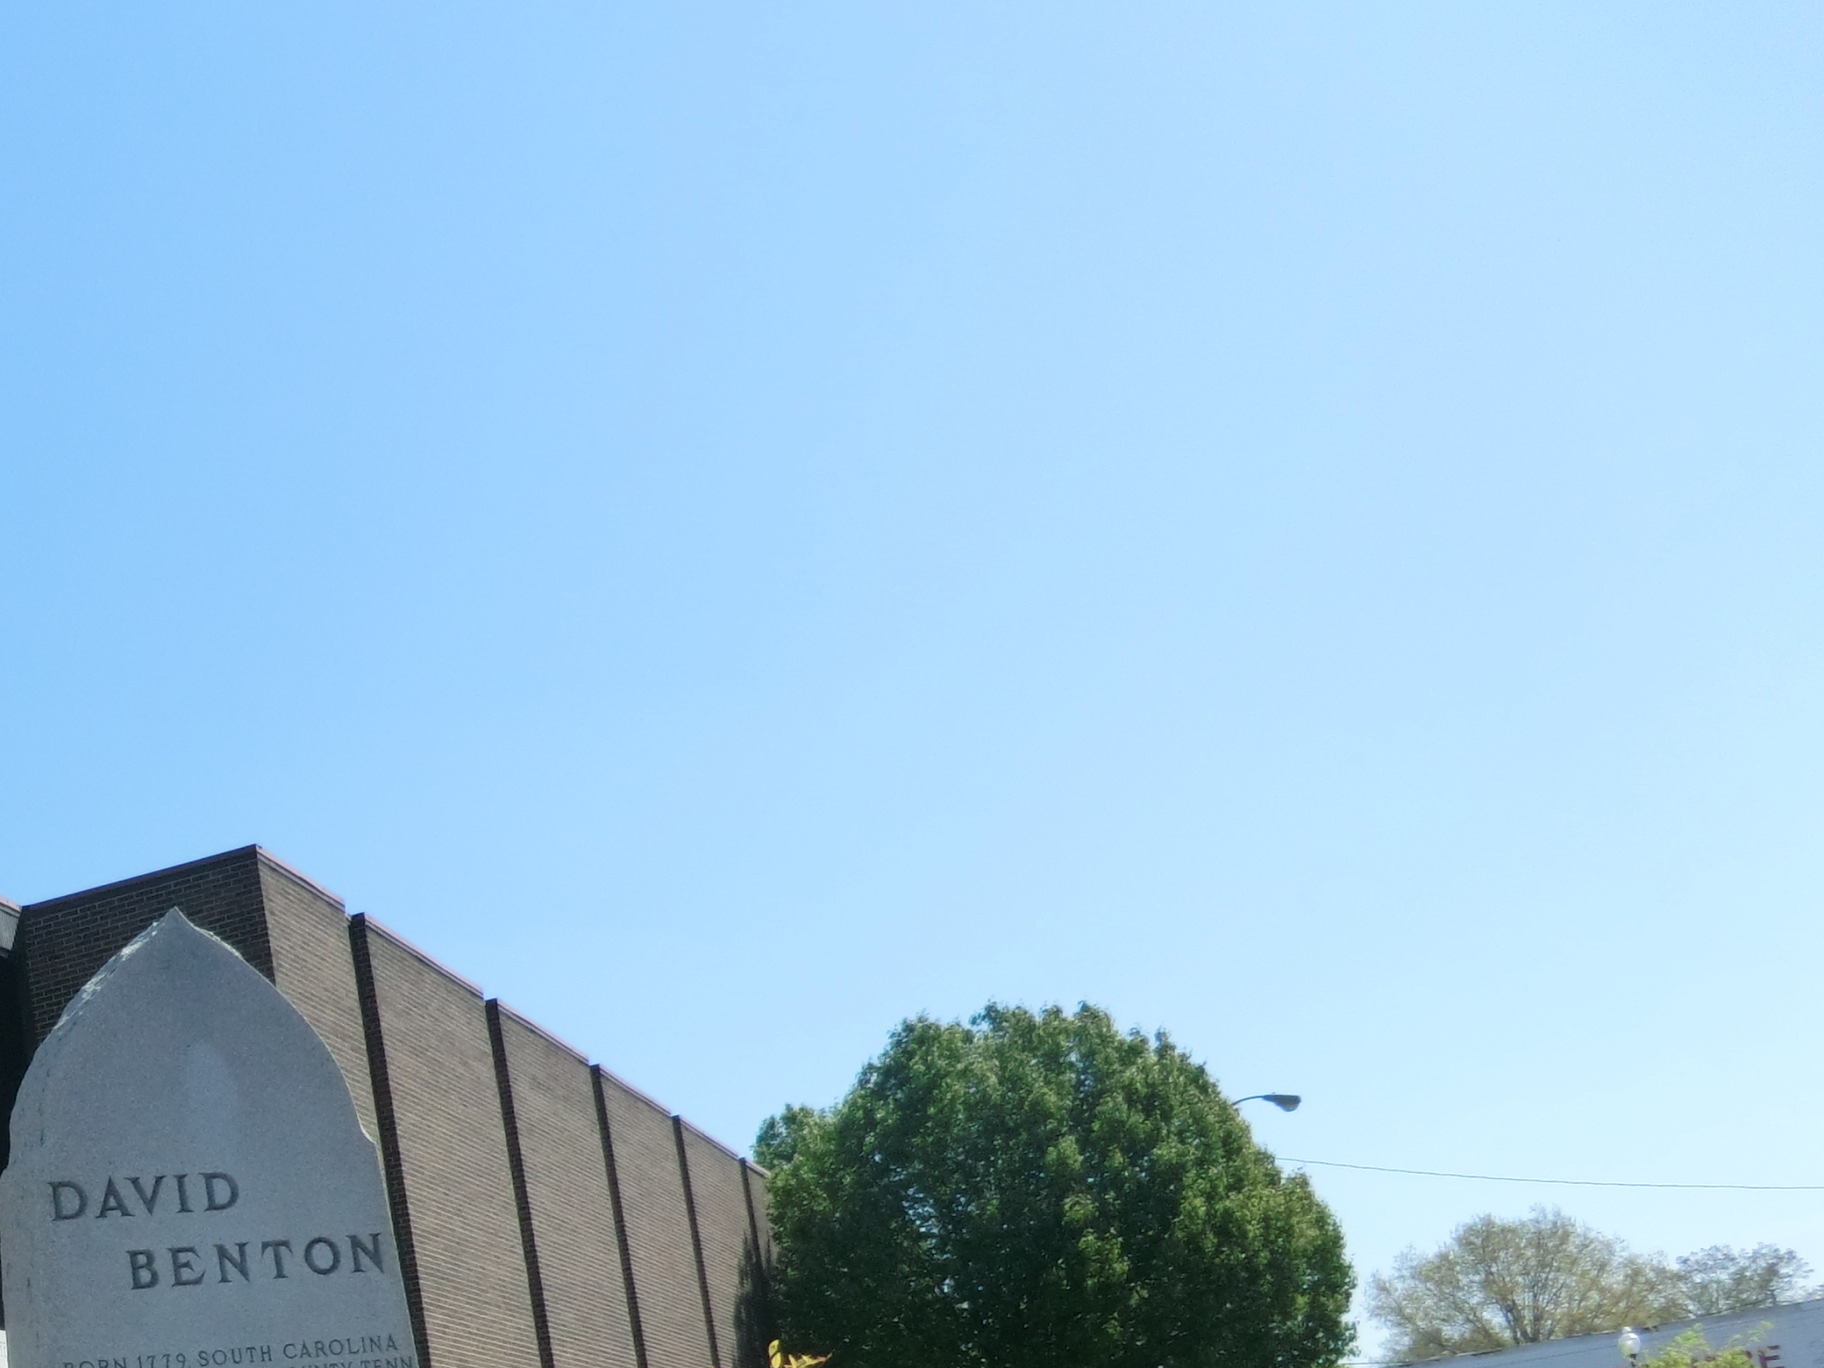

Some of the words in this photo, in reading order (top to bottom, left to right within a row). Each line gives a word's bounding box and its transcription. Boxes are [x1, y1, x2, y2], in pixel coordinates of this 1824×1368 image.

[47, 1171, 240, 1222] DAVID
[126, 1232, 385, 1290] BENTON
[198, 1345, 273, 1368] SOUTH
[283, 1334, 398, 1359] CAROLINA
